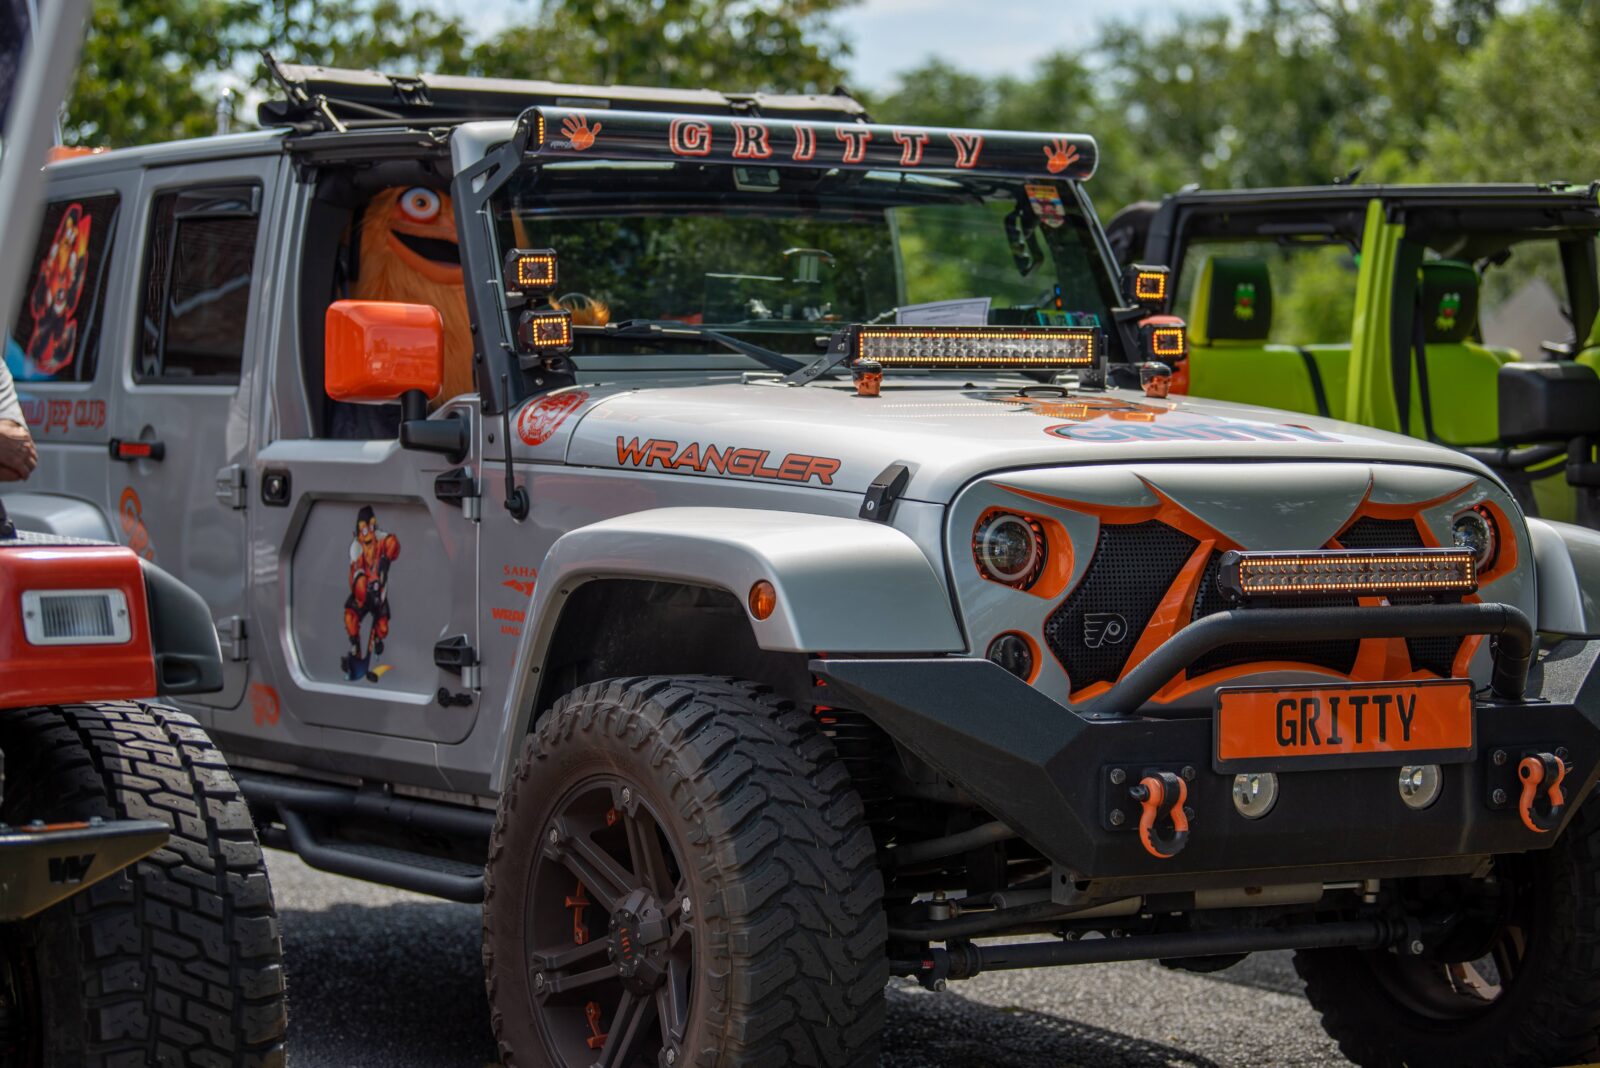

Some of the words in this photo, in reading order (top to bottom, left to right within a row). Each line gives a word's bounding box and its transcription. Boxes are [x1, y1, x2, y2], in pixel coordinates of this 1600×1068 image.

[669, 118, 984, 169] GRITTY
[45, 400, 73, 433] JEEP
[74, 400, 106, 429] CLUB
[616, 436, 842, 486] WRANGLER
[503, 564, 539, 579] SAHA
[490, 607, 527, 625] WRAN
[1276, 693, 1417, 747] GRITTY
